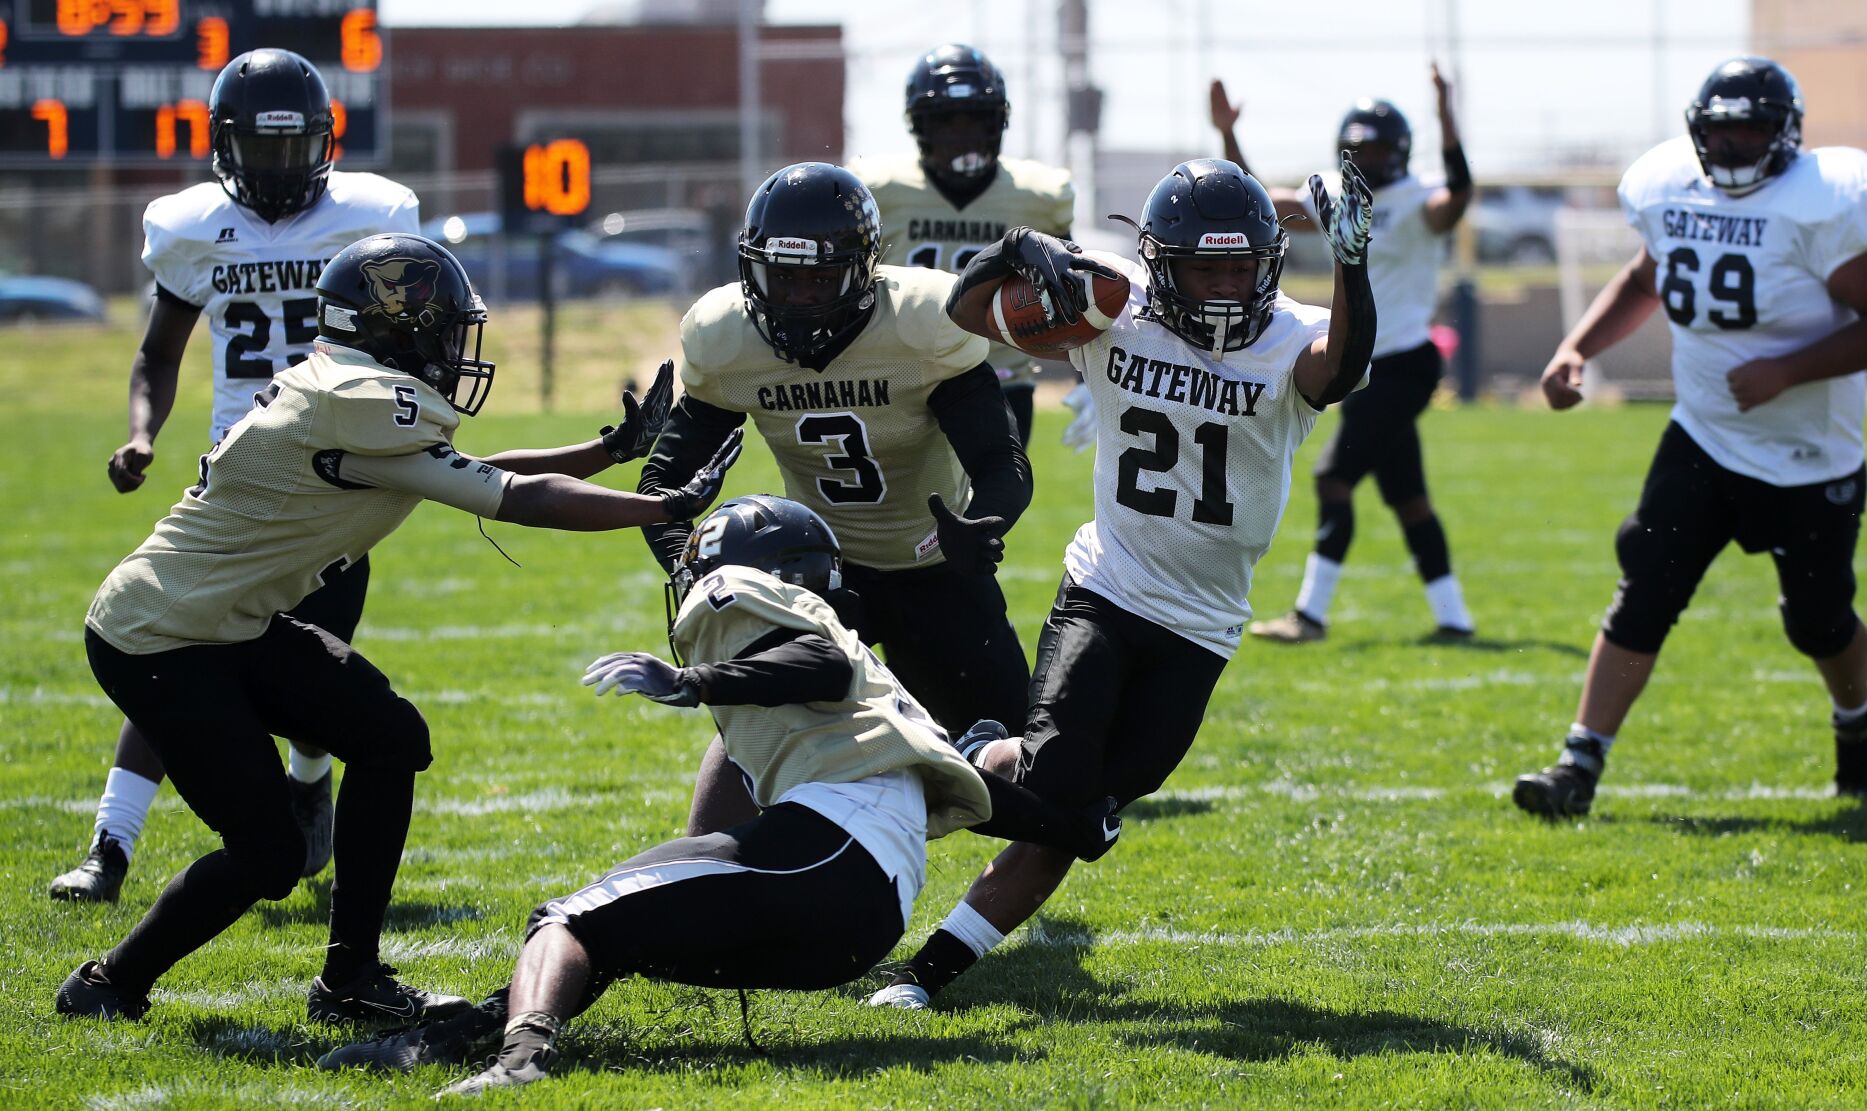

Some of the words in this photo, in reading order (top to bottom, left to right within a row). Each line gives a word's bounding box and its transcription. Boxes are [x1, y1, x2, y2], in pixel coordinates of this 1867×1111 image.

[340, 8, 383, 73] 6
[31, 99, 69, 160] 7
[267, 113, 293, 121] Riddell
[523, 138, 591, 215] 10
[778, 240, 807, 250] Riddell
[1205, 236, 1244, 245] Riddell
[1662, 208, 1768, 247] GATEWAY
[212, 258, 331, 294] GATEWA
[1661, 246, 1759, 331] 69
[223, 297, 320, 379] 25
[757, 379, 890, 411] CARNAHAN
[1106, 346, 1266, 417] GATEWAY
[392, 385, 420, 427] 5
[795, 411, 888, 507] 3
[1116, 405, 1234, 527] 21
[698, 515, 730, 558] 2
[702, 573, 738, 613] 2
